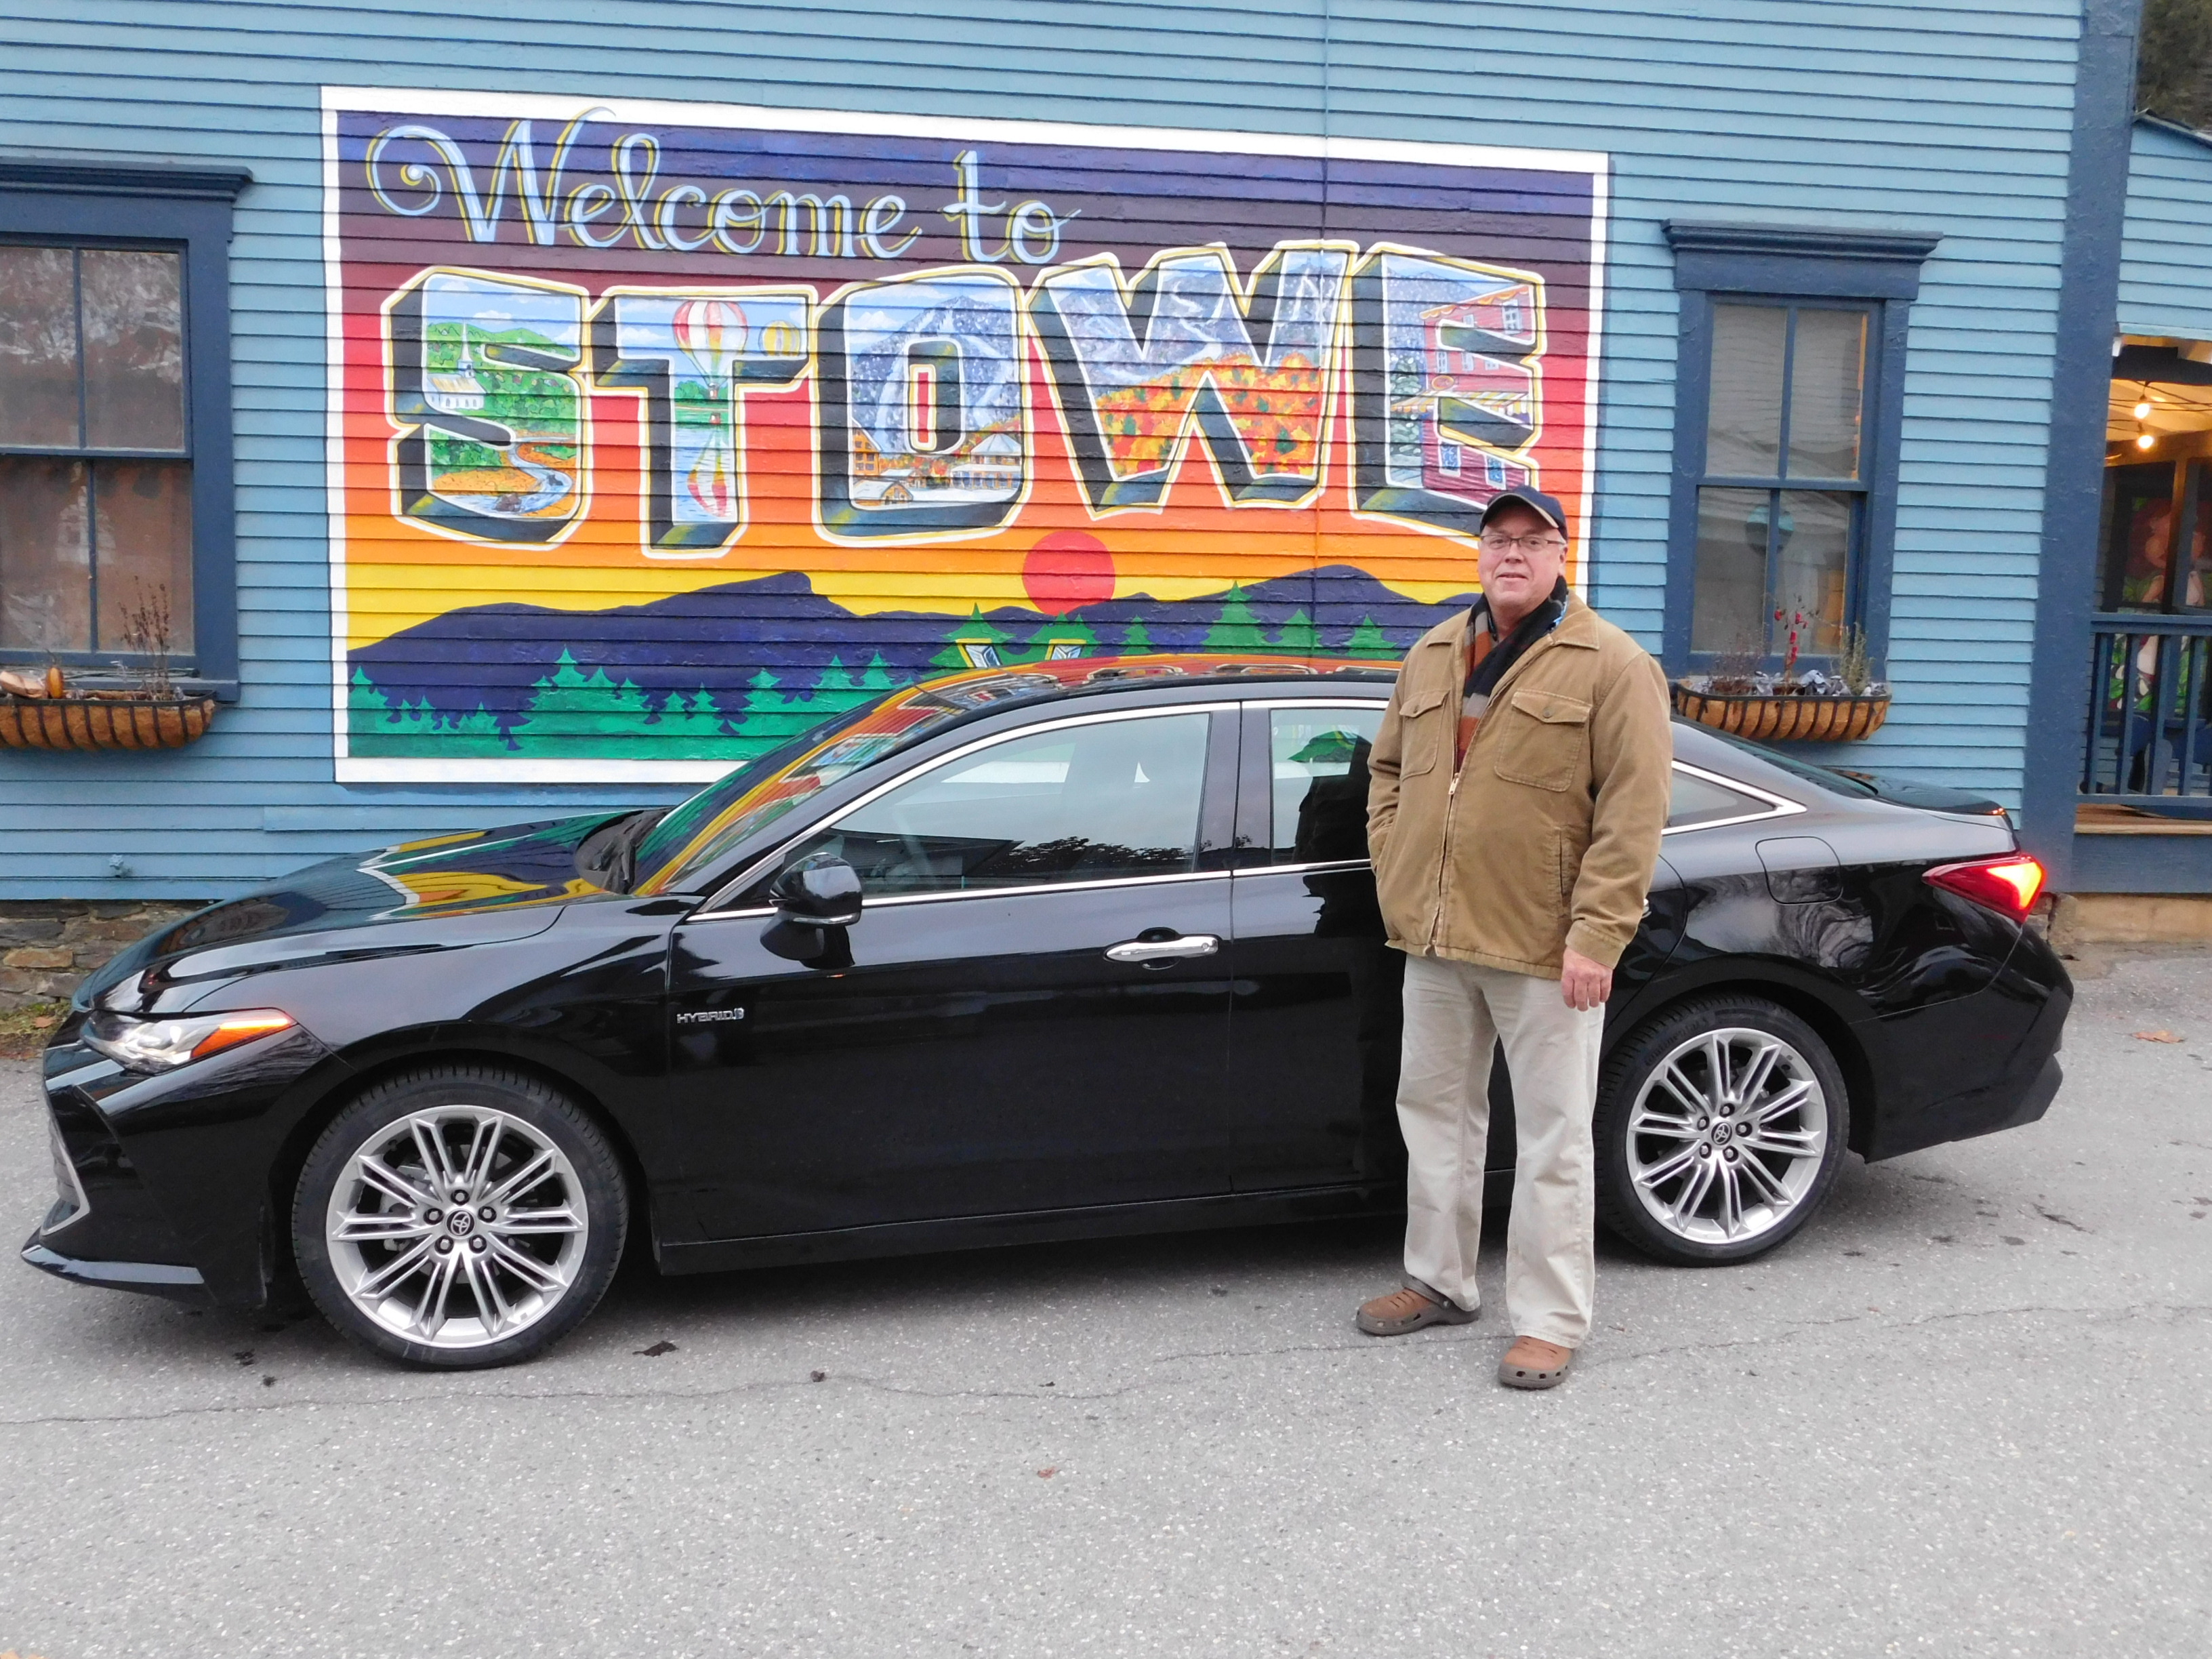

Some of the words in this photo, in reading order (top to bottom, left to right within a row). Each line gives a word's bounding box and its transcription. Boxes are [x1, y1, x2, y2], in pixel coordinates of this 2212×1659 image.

[366, 107, 922, 262] Welcome
[941, 150, 1082, 264] to
[380, 239, 1547, 560] STOWE
[676, 1010, 733, 1024] HYBRID
